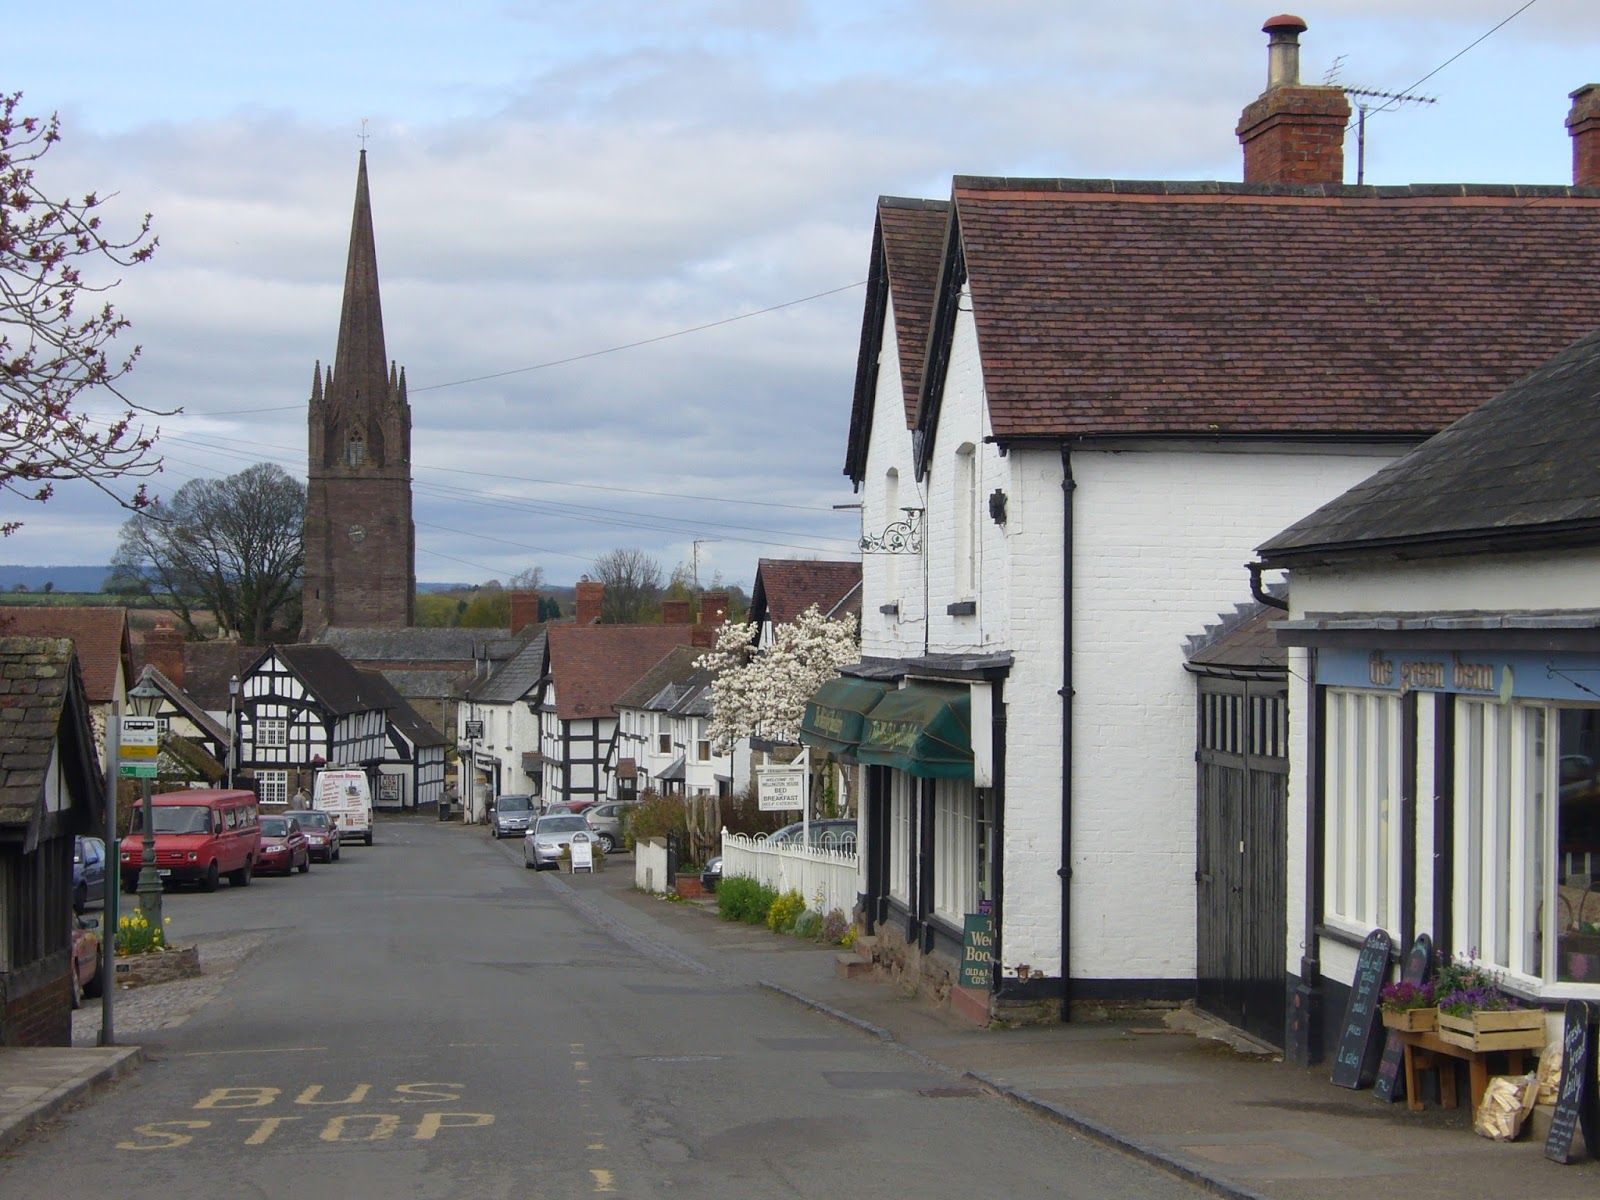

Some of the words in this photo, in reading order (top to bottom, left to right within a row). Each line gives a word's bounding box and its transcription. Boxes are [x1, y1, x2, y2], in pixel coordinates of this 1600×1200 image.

[1368, 649, 1392, 685] the
[1400, 660, 1445, 696] green
[1452, 649, 1494, 691] bean
[965, 967, 979, 976] OLD
[1565, 1020, 1583, 1053] fresh
[1569, 1032, 1586, 1072] bread
[192, 1082, 466, 1110] BUS
[1562, 1068, 1582, 1104] daily
[115, 1112, 496, 1151] STOP
